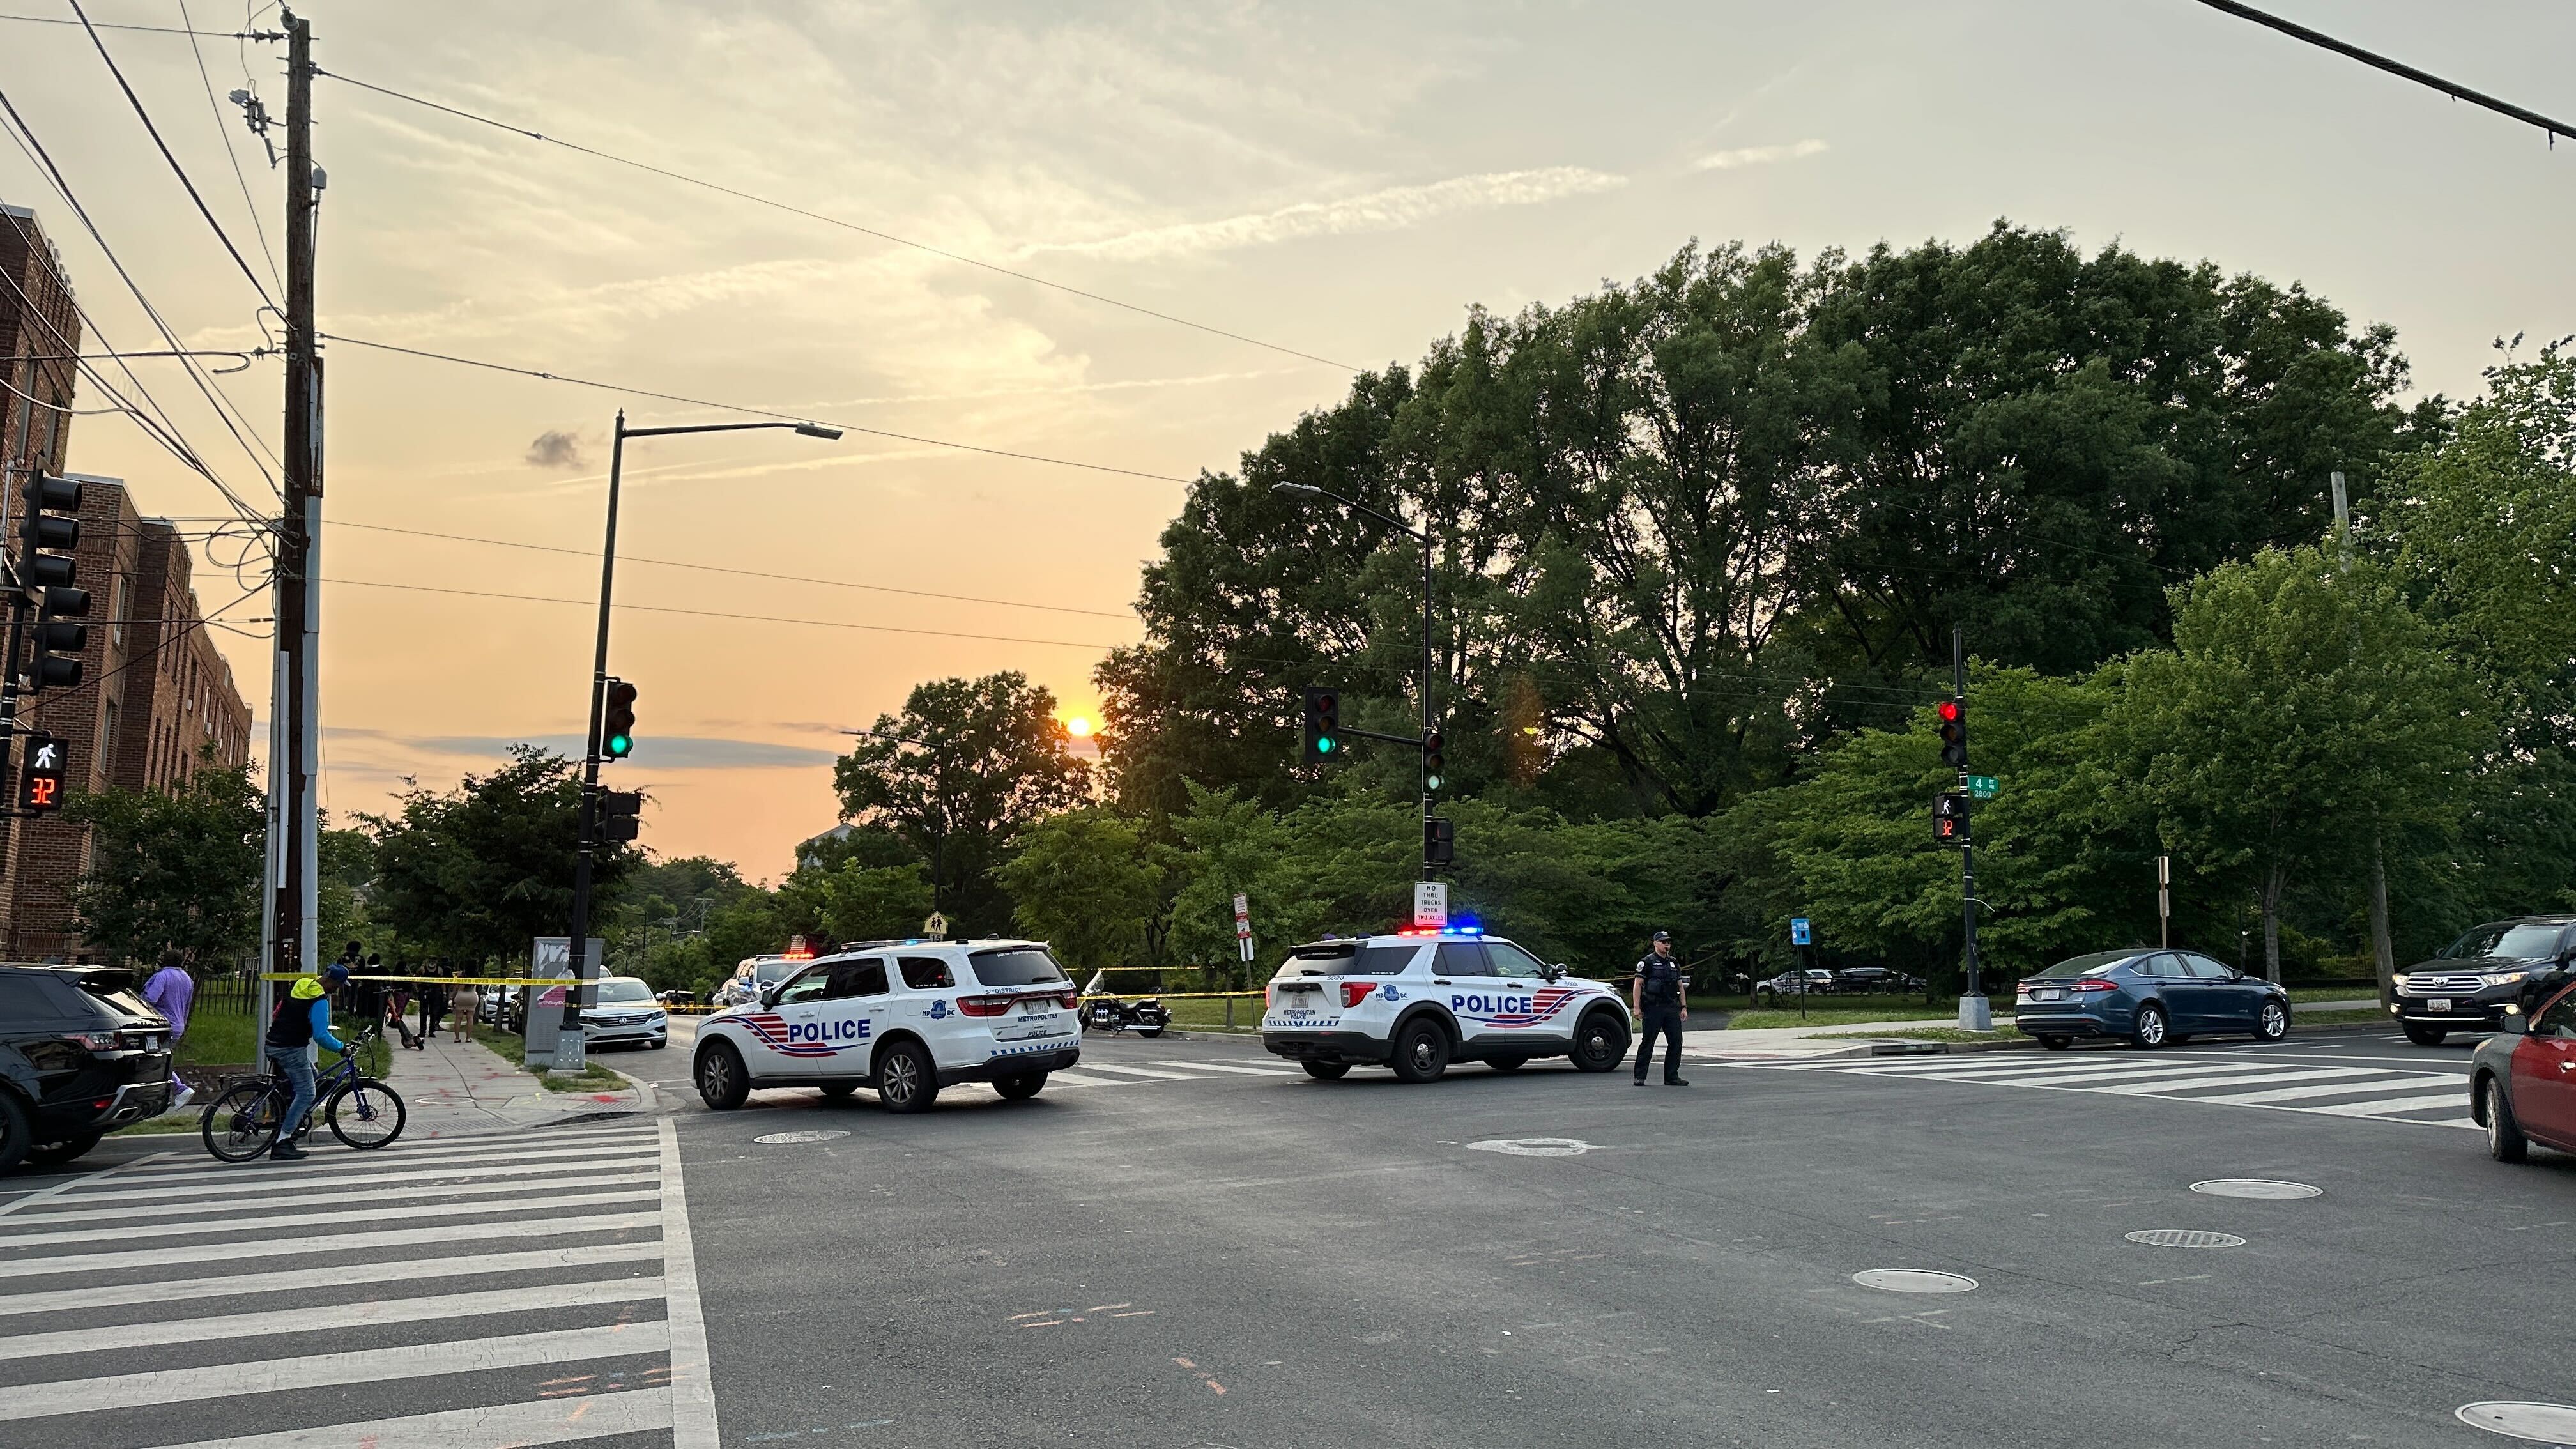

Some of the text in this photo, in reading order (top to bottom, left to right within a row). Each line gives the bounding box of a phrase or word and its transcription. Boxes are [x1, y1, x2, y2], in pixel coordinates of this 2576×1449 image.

[31, 778, 55, 804] 32
[1975, 778, 1982, 788] 4
[1942, 820, 1953, 836] 32
[1451, 995, 1532, 1014] POLICE
[1018, 1013, 1058, 1022] METROPOLITAN
[789, 1018, 871, 1042] POLICE
